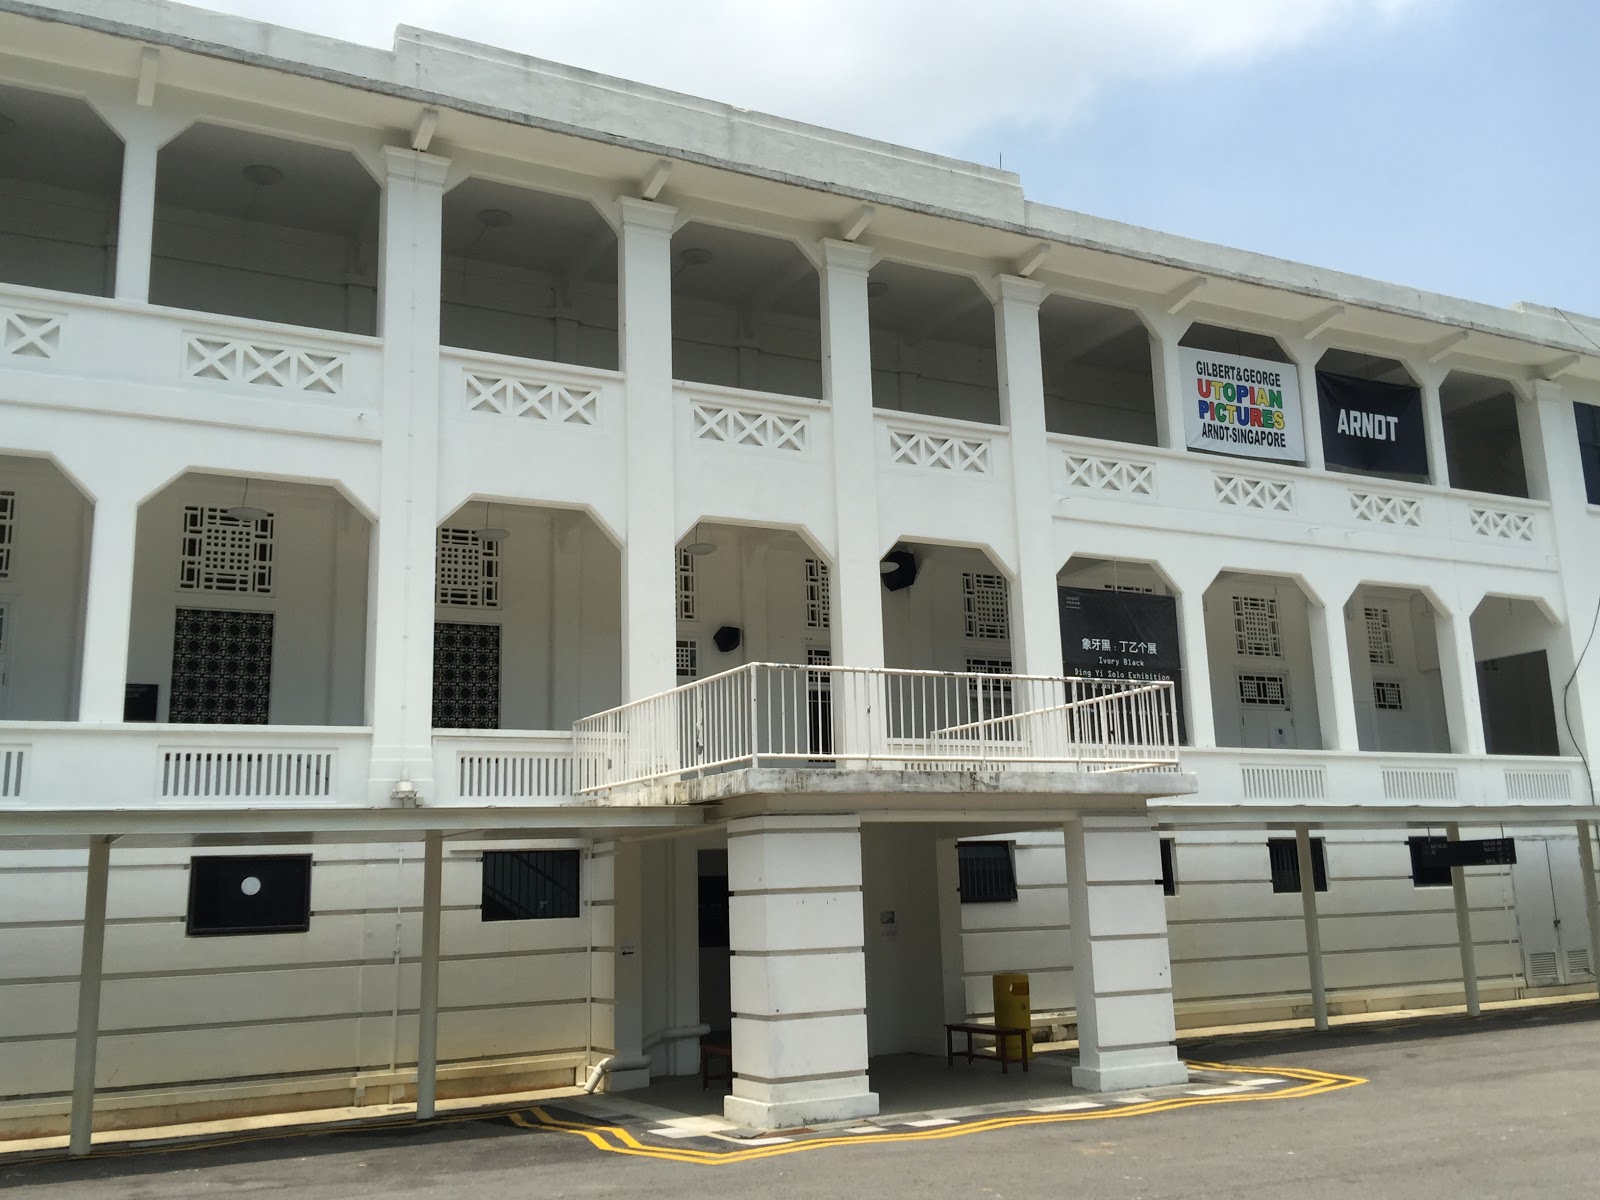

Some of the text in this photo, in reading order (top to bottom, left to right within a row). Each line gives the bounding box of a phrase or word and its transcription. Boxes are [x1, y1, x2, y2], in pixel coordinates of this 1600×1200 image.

[1196, 360, 1281, 388] GILBERT&GEORGE
[1197, 378, 1283, 409] UTOPIAN
[1198, 399, 1285, 431] PICTURES
[1337, 408, 1399, 442] ARNDT
[1201, 422, 1286, 448] ARNDT-SINGAPORE
[1074, 667, 1171, 681] Ding Yi Solo Exhibition
[1098, 656, 1144, 667] Ivory Black
